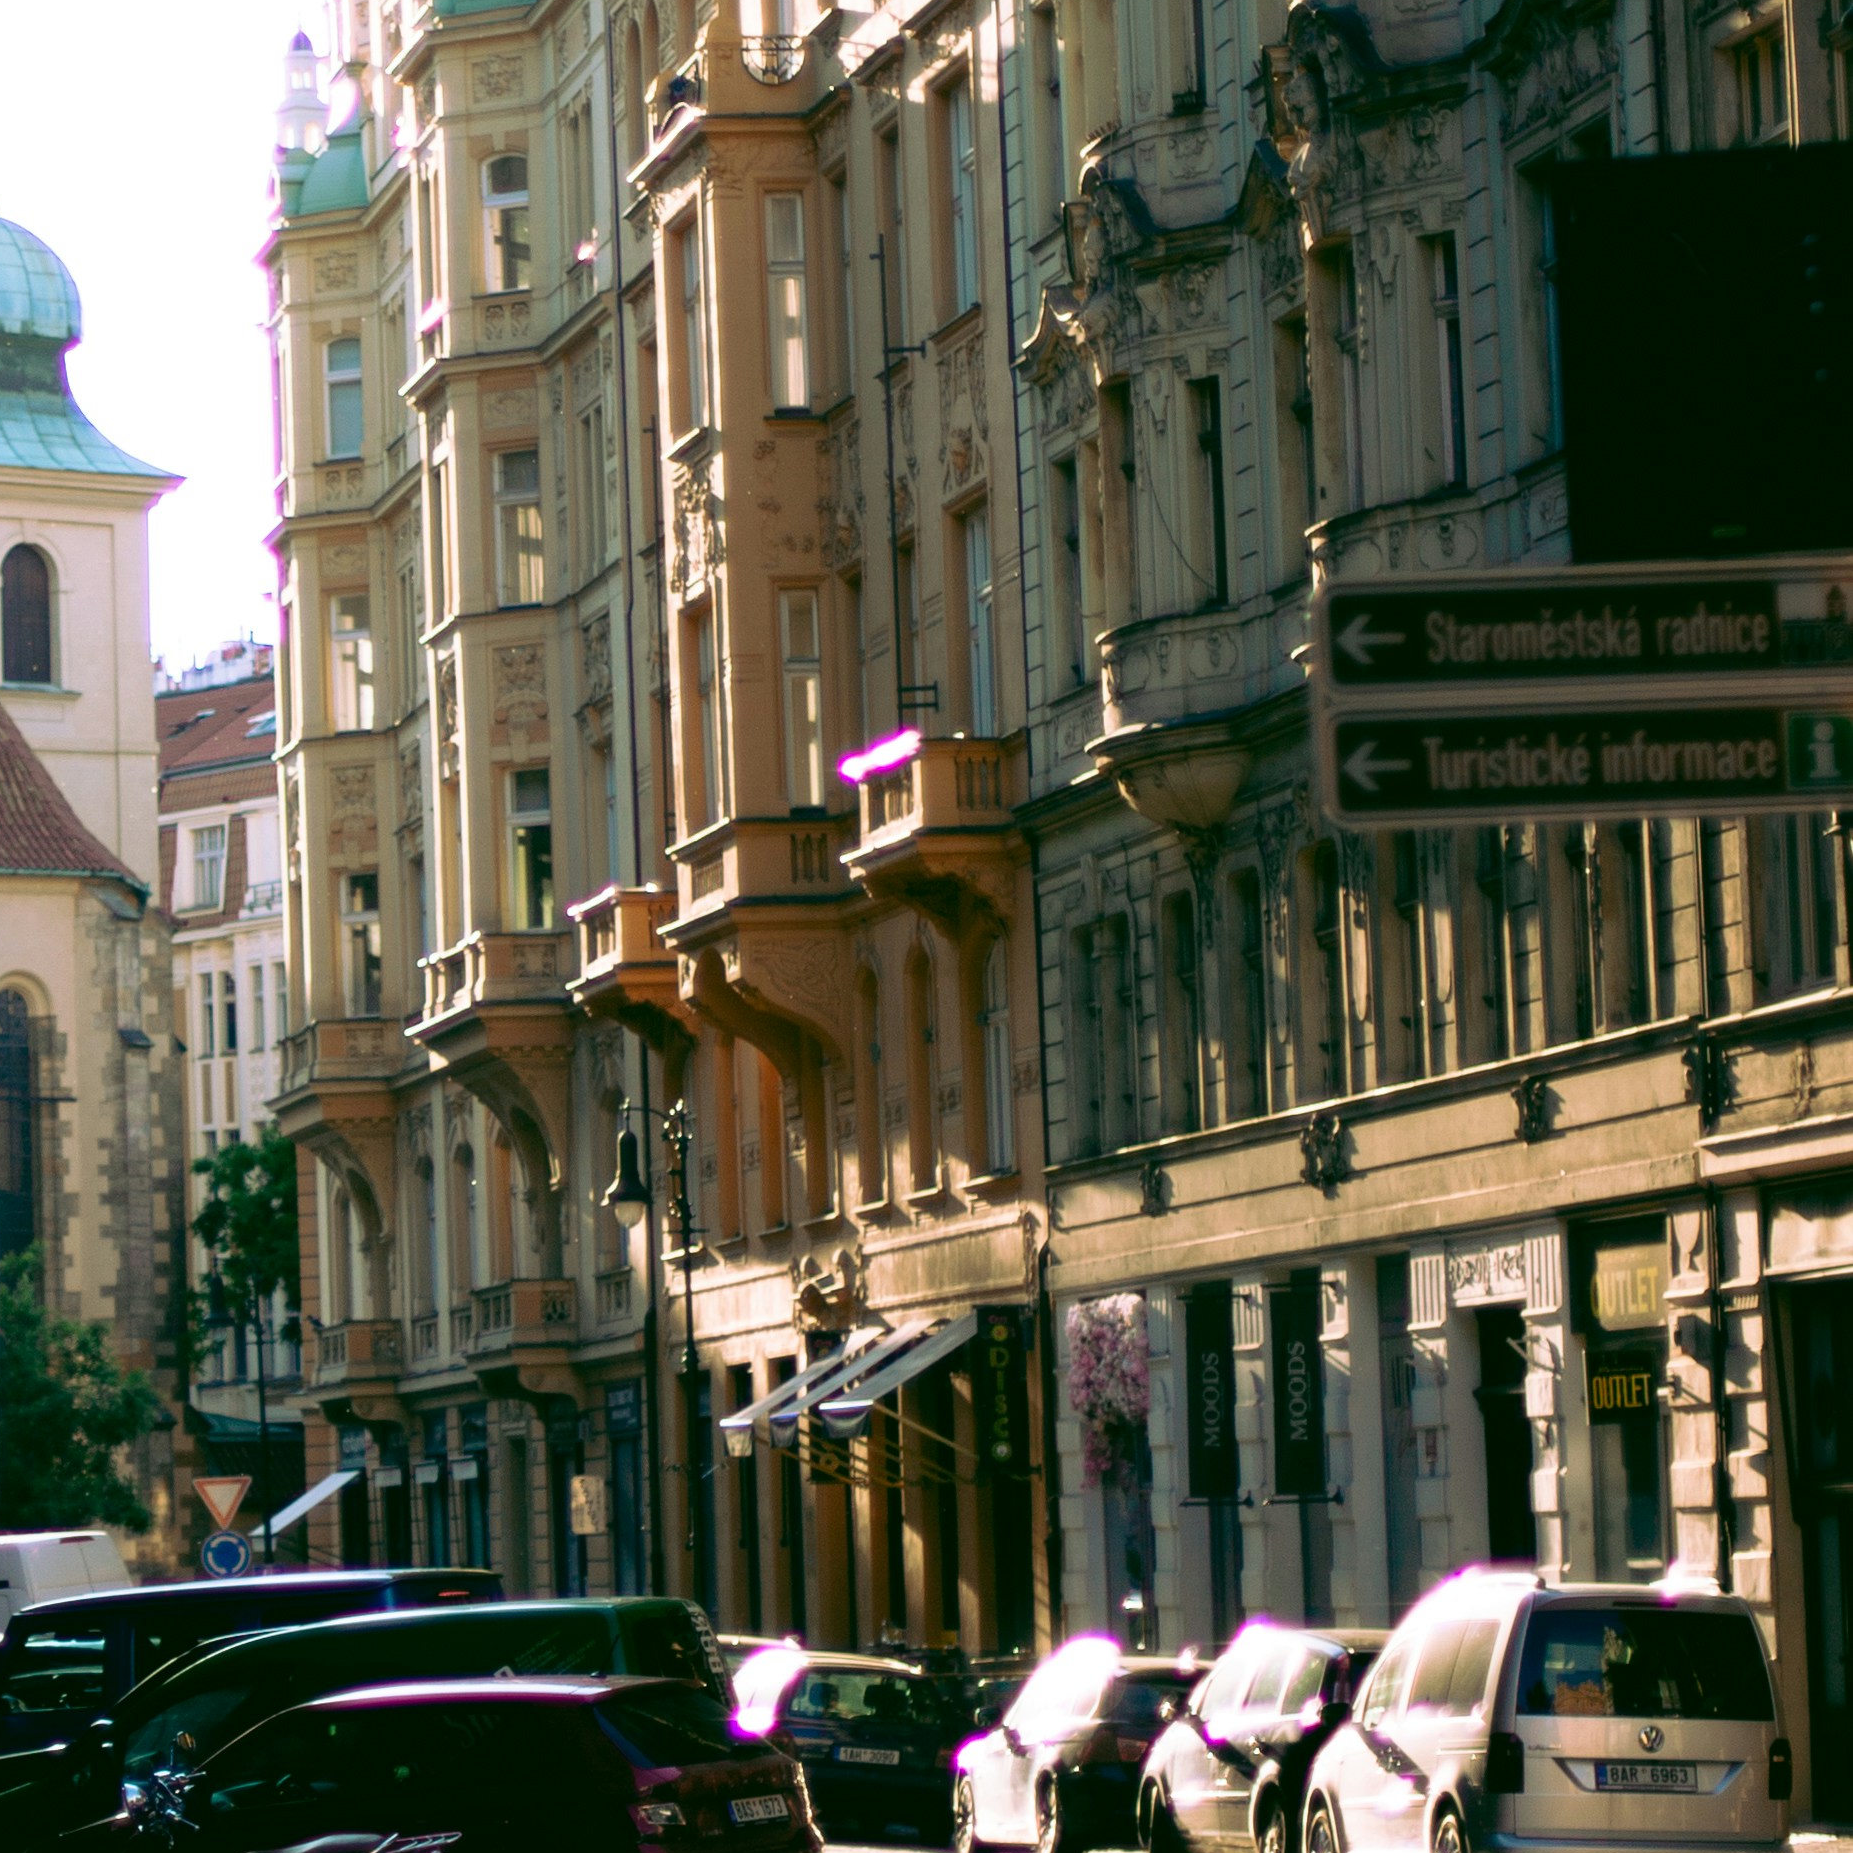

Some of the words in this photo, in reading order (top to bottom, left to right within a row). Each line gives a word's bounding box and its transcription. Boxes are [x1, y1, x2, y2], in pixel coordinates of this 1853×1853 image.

[1424, 605, 1642, 666] Staroměstská
[1655, 600, 1771, 657] radnice
[1421, 729, 1592, 792] Turistické
[1601, 727, 1778, 784] informace
[1201, 1351, 1221, 1448] MOODS
[1287, 1339, 1309, 1441] MOODS
[1592, 1372, 1652, 1411] OUTLET
[1610, 1764, 1639, 1784] 8AR
[1651, 1766, 1689, 1784] 6963
